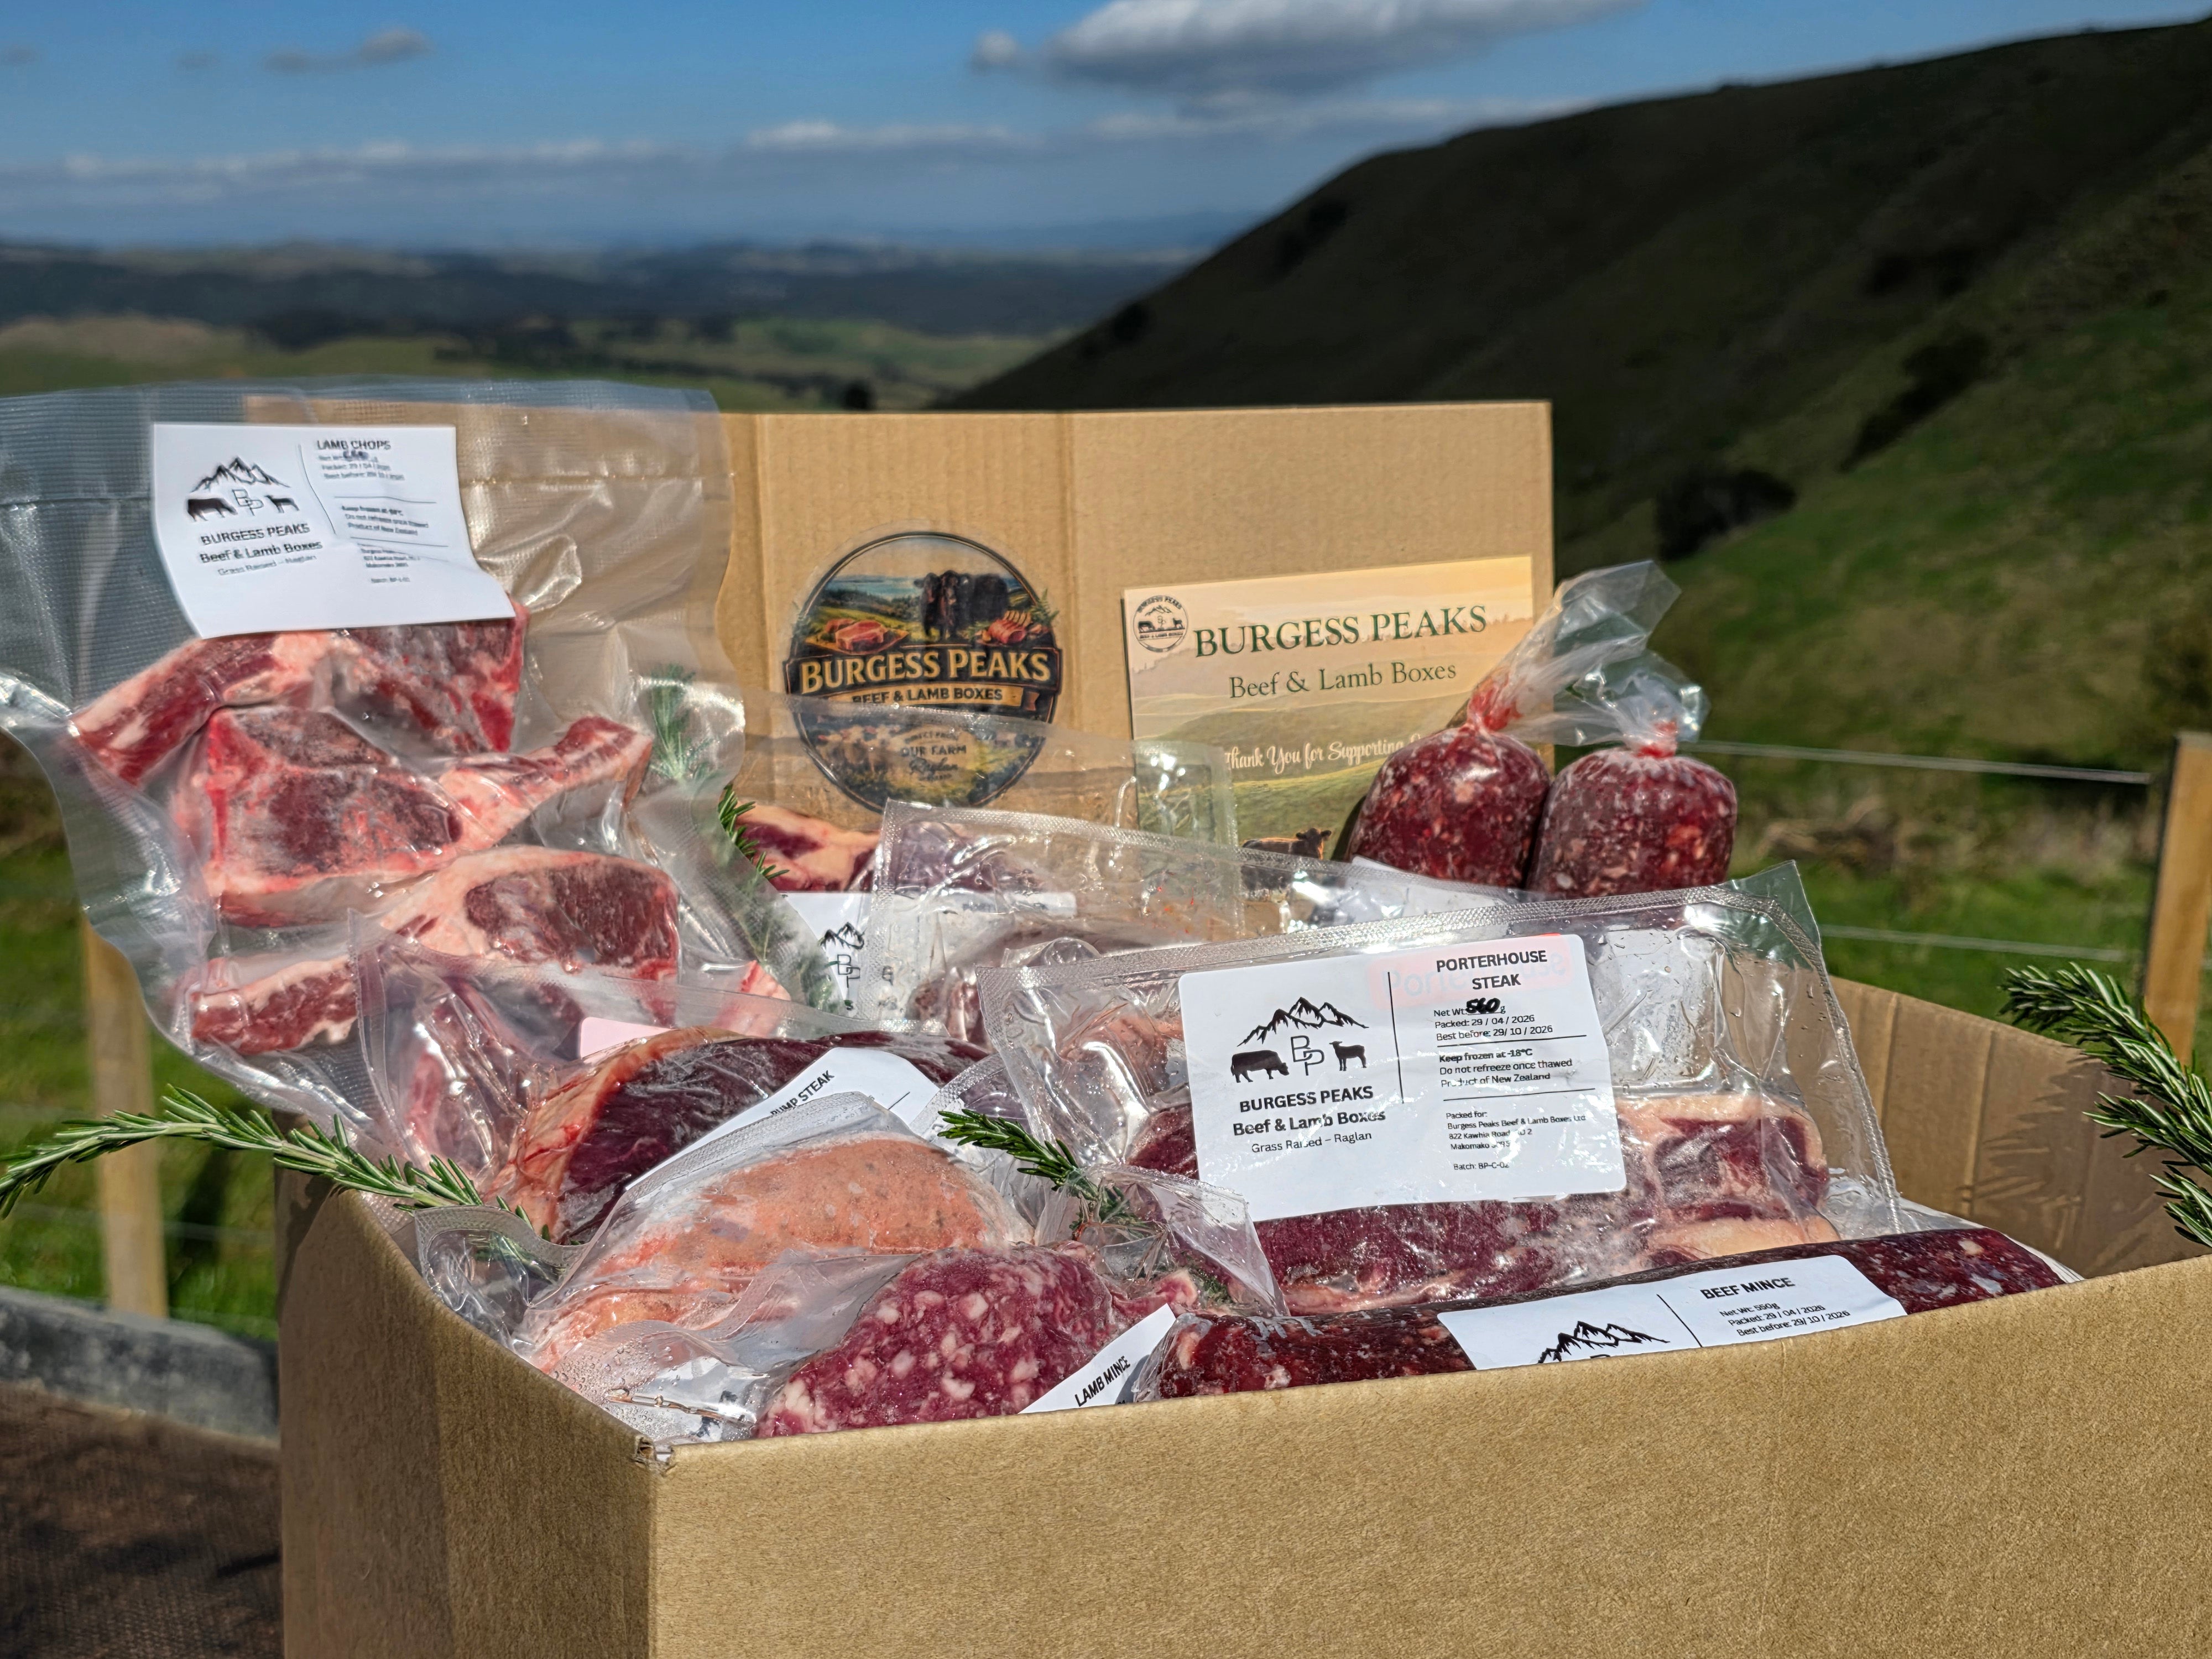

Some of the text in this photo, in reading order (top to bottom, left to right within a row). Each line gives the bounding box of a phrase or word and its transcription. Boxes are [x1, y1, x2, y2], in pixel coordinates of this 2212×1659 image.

[317, 440, 391, 450] LAMB CHOPS
[201, 523, 310, 545] BURGESS PEAKS
[200, 541, 323, 563] Beef & Lamb Boxes
[1193, 605, 1486, 658] BURGESS PEAKS
[800, 649, 1051, 695] BURGESS PEAKS
[1229, 661, 1456, 698] Beef & Lamb Boxes
[893, 691, 904, 702] &
[907, 688, 949, 701] LAMB
[953, 688, 1003, 700] BOXES
[932, 745, 966, 755] FARM
[1266, 746, 1301, 774] You
[1305, 742, 1324, 769] for
[1436, 950, 1547, 972] PORTERHOUSE
[1472, 974, 1521, 990] STEAK
[1500, 1005, 1506, 1014] g
[1434, 1019, 1470, 1029] Packed:
[1491, 1016, 1504, 1025] 04
[1511, 1014, 1535, 1024] 2026
[1437, 1033, 1456, 1041] Best
[1458, 1030, 1491, 1039] before:
[1493, 1027, 1507, 1037] 29/
[1510, 1027, 1521, 1035] 10
[1530, 1025, 1553, 1034] 2026
[1291, 1035, 1325, 1076] BP
[1439, 1055, 1463, 1063] Keep
[1455, 1066, 1471, 1074] not
[1473, 1063, 1511, 1072] refreeze
[1513, 1062, 1536, 1070] once
[1537, 1058, 1573, 1069] thawed
[798, 1070, 834, 1101] STEAK
[1441, 1078, 1478, 1088] Prduct
[1491, 1076, 1511, 1084] New
[1514, 1073, 1551, 1082] Zealand
[1240, 1086, 1374, 1113] BURGESS PEAKS
[1233, 1110, 1386, 1136] Beef & Lamb Boxes
[1448, 1122, 1477, 1130] Burgess
[1478, 1120, 1500, 1128] Peaks
[1501, 1118, 1519, 1126] Beef
[1527, 1116, 1549, 1124] Lamb
[1251, 1143, 1283, 1153] Grass
[1286, 1136, 1322, 1149] Raied
[1334, 1131, 1372, 1144] Raglan
[1451, 1142, 1490, 1150] Makomako
[1700, 1277, 1796, 1299] BEEF MINCE
[1720, 1309, 1739, 1317] Net
[1754, 1302, 1780, 1312] 550g
[1728, 1316, 1764, 1326] Packed:
[1802, 1305, 1825, 1313] 2026
[1737, 1326, 1759, 1336] Best
[1761, 1322, 1791, 1332] before:
[1792, 1317, 1807, 1326] 29/
[1827, 1310, 1851, 1320] 2026
[1074, 1355, 1130, 1407] LAMB MINCE
